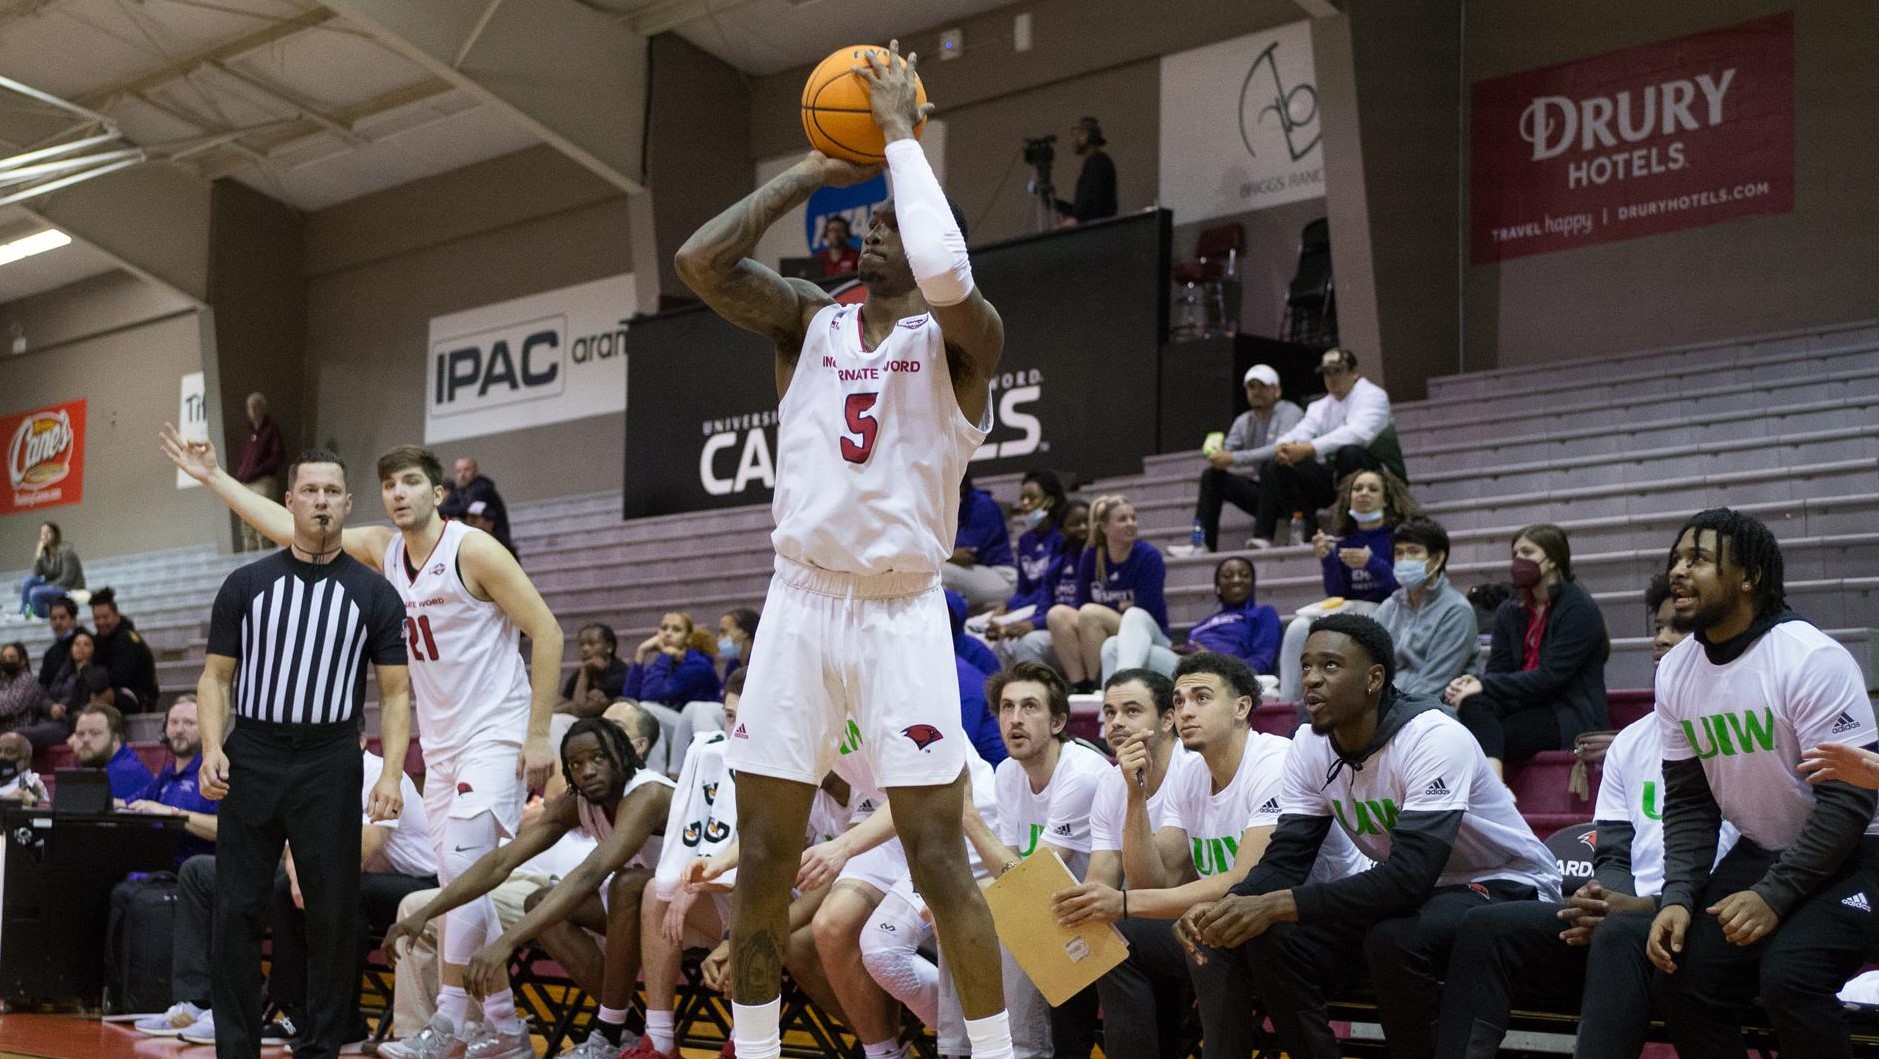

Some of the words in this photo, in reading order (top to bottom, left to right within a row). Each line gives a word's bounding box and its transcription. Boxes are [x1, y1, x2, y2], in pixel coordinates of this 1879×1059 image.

[1518, 68, 1736, 162] DRURY
[1287, 169, 1325, 187] RANC
[1568, 142, 1685, 190] HOTELS
[1492, 225, 1541, 242] TRAVEL
[1545, 213, 1593, 236] happy
[1618, 182, 1770, 221] DRURYHOTELS.COM
[436, 330, 559, 405] IPAC
[702, 409, 778, 436] UNIVERSI
[840, 392, 878, 464] 5
[1679, 706, 1775, 760] UIW
[1831, 721, 1861, 735] adidas
[1425, 787, 1450, 796] adidas
[1259, 806, 1282, 815] adidas
[1841, 898, 1871, 913] adidas
